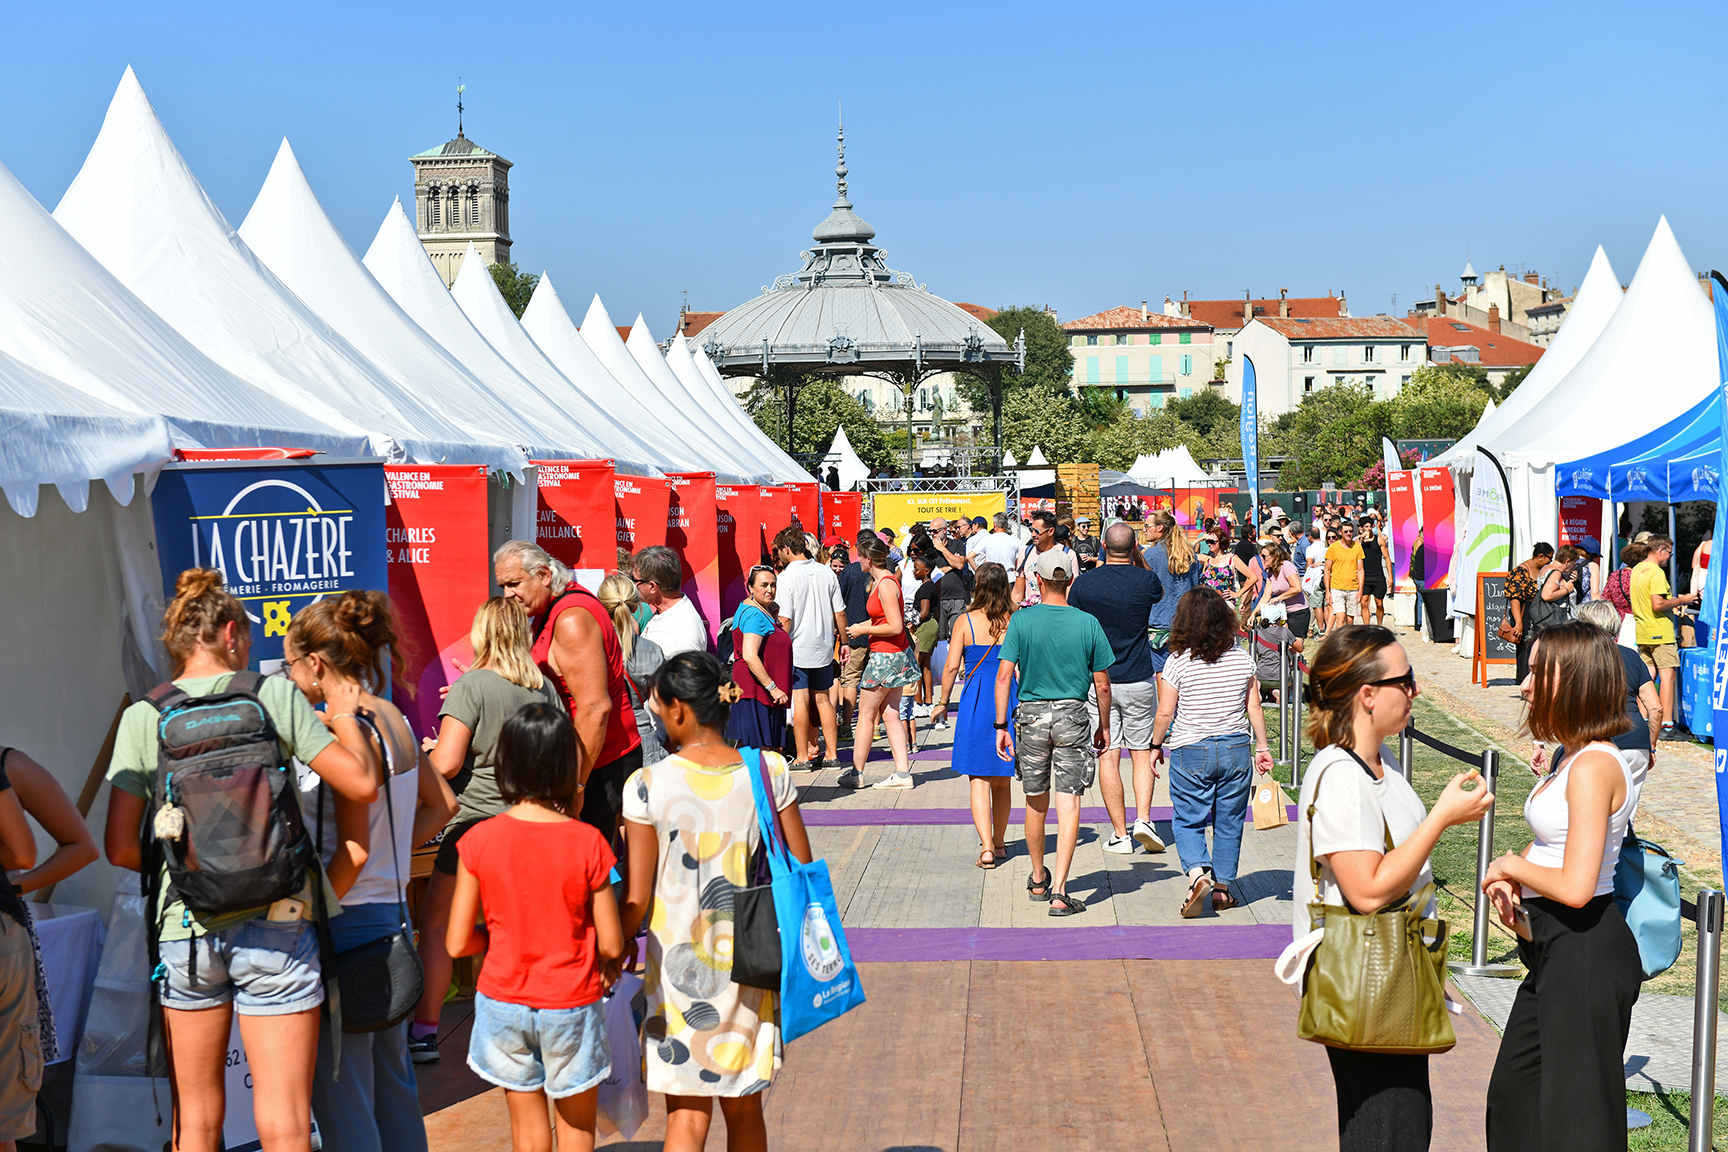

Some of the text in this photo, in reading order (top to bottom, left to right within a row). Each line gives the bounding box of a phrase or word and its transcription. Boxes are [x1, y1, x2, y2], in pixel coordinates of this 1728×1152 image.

[385, 472, 430, 481] VALENCE EN
[390, 490, 420, 498] ESTIVAL
[669, 507, 684, 516] ISON
[616, 518, 635, 529] AINE
[667, 518, 690, 528] ABRAN
[386, 528, 436, 543] CHARLES
[616, 531, 635, 542] GIER
[386, 548, 430, 563] & ALICE
[272, 579, 339, 593] FROMAGERIE
[185, 714, 242, 730] DAKINE
[822, 953, 842, 974] TERRO
[822, 990, 831, 999] La
